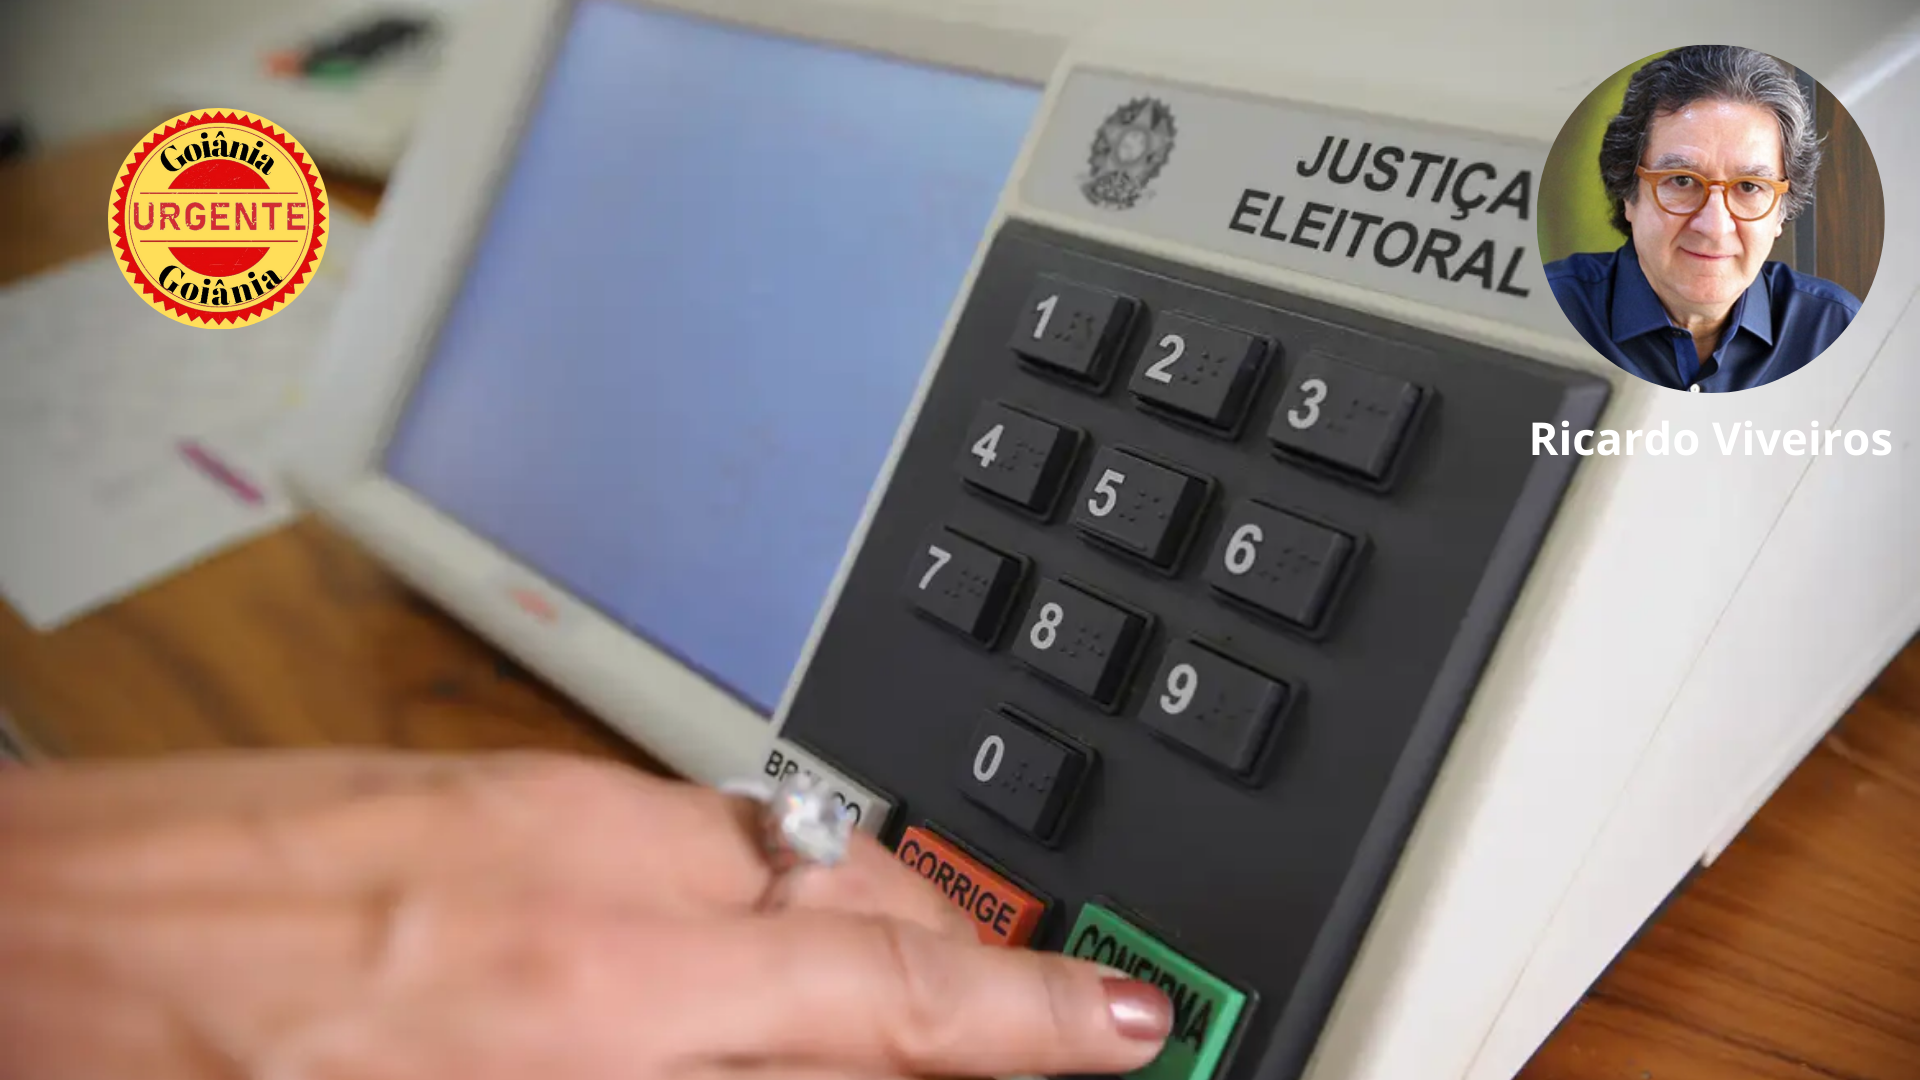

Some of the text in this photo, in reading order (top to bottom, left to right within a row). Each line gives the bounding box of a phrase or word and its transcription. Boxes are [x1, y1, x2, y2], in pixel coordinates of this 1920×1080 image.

[1296, 135, 1534, 221] JUSTIÇA
[1227, 188, 1533, 298] ELEITORAL
[1034, 295, 1060, 339] 1
[1145, 334, 1186, 384] 2
[1287, 379, 1328, 430] 3
[971, 424, 1004, 467] 4
[1087, 469, 1126, 516] 5
[918, 546, 952, 590] 7
[1224, 524, 1263, 575] 6
[1029, 602, 1064, 649] 8
[1159, 663, 1198, 714] 9
[973, 735, 1005, 781] 0
[764, 749, 862, 828] BRO
[900, 840, 1016, 937] CORRIGE
